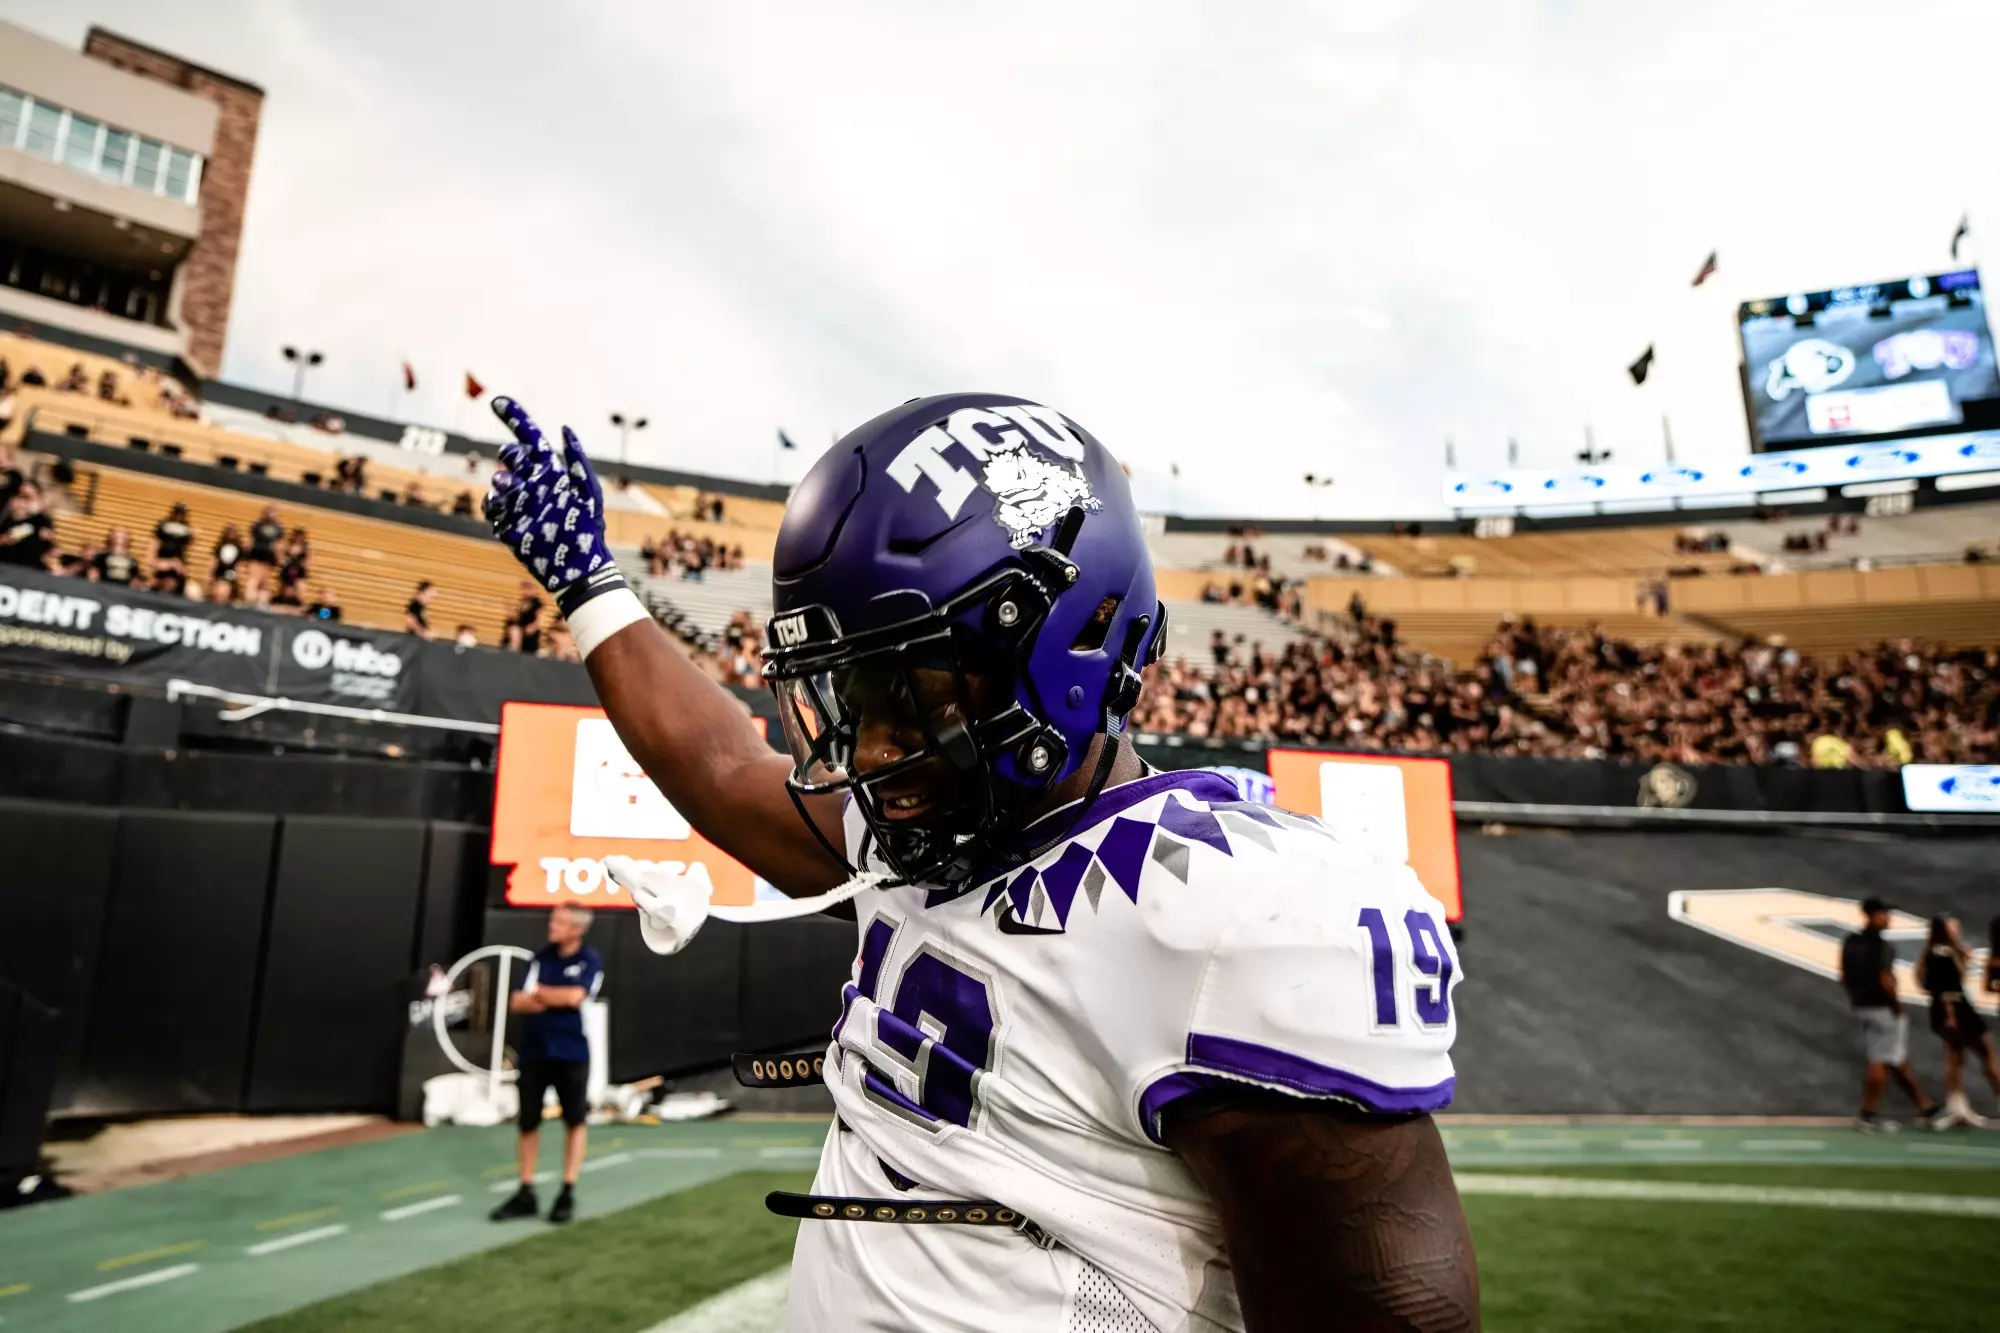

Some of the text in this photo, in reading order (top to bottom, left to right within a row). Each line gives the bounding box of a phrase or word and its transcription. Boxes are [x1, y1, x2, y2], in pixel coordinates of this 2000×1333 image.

[886, 405, 1085, 521] TCU
[104, 603, 262, 656] SECTION
[774, 613, 808, 647] TCU
[1357, 907, 1453, 1027] 19
